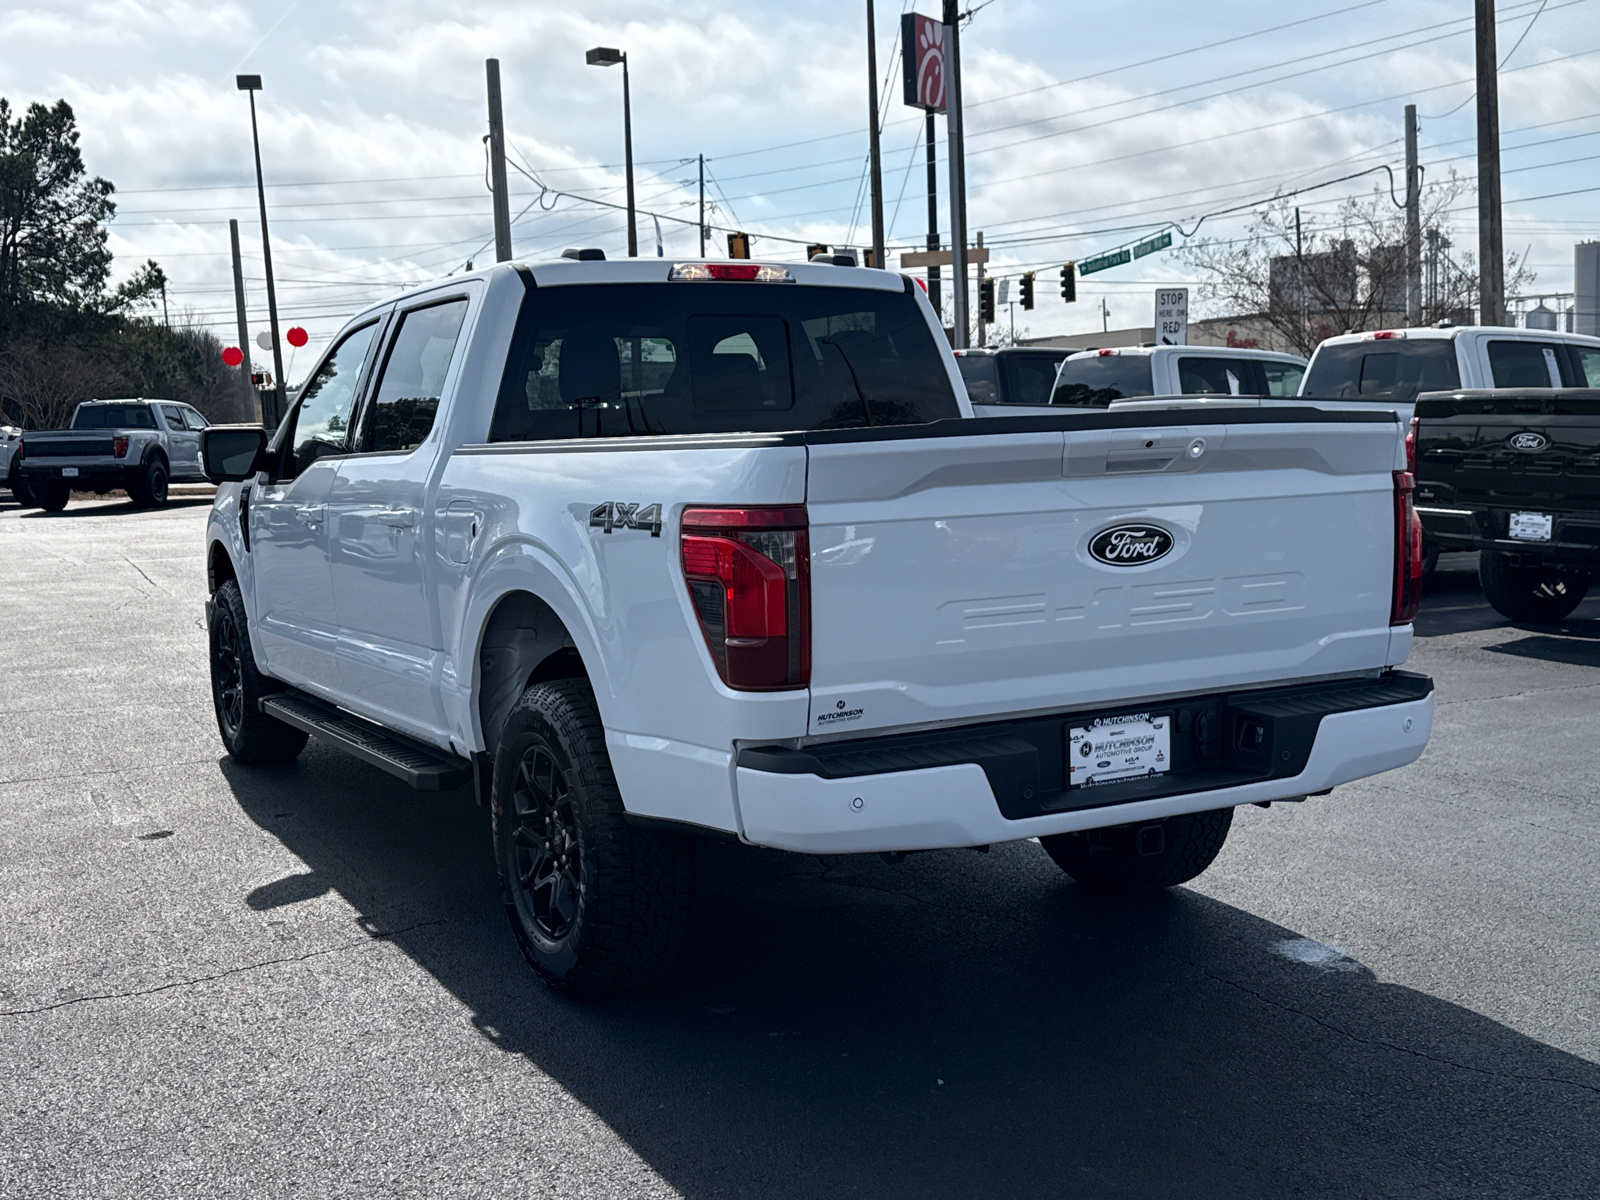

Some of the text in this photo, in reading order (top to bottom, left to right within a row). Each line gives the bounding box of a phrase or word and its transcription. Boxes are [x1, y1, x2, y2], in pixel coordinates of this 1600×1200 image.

[1154, 238, 1163, 249] Rd
[1109, 254, 1121, 266] Park
[1122, 252, 1129, 263] Rd
[1160, 293, 1183, 305] STOP
[1159, 309, 1186, 317] HERE ON
[1163, 321, 1180, 333] RED
[1516, 435, 1539, 447] Ford
[1105, 531, 1159, 559] Ford
[817, 708, 864, 721] HUTCHINSON
[1102, 712, 1150, 726] HUTCHINSON
[1094, 734, 1156, 753] HUTCHINSON
[1095, 744, 1153, 760] AUTOMOTIVE GROUP
